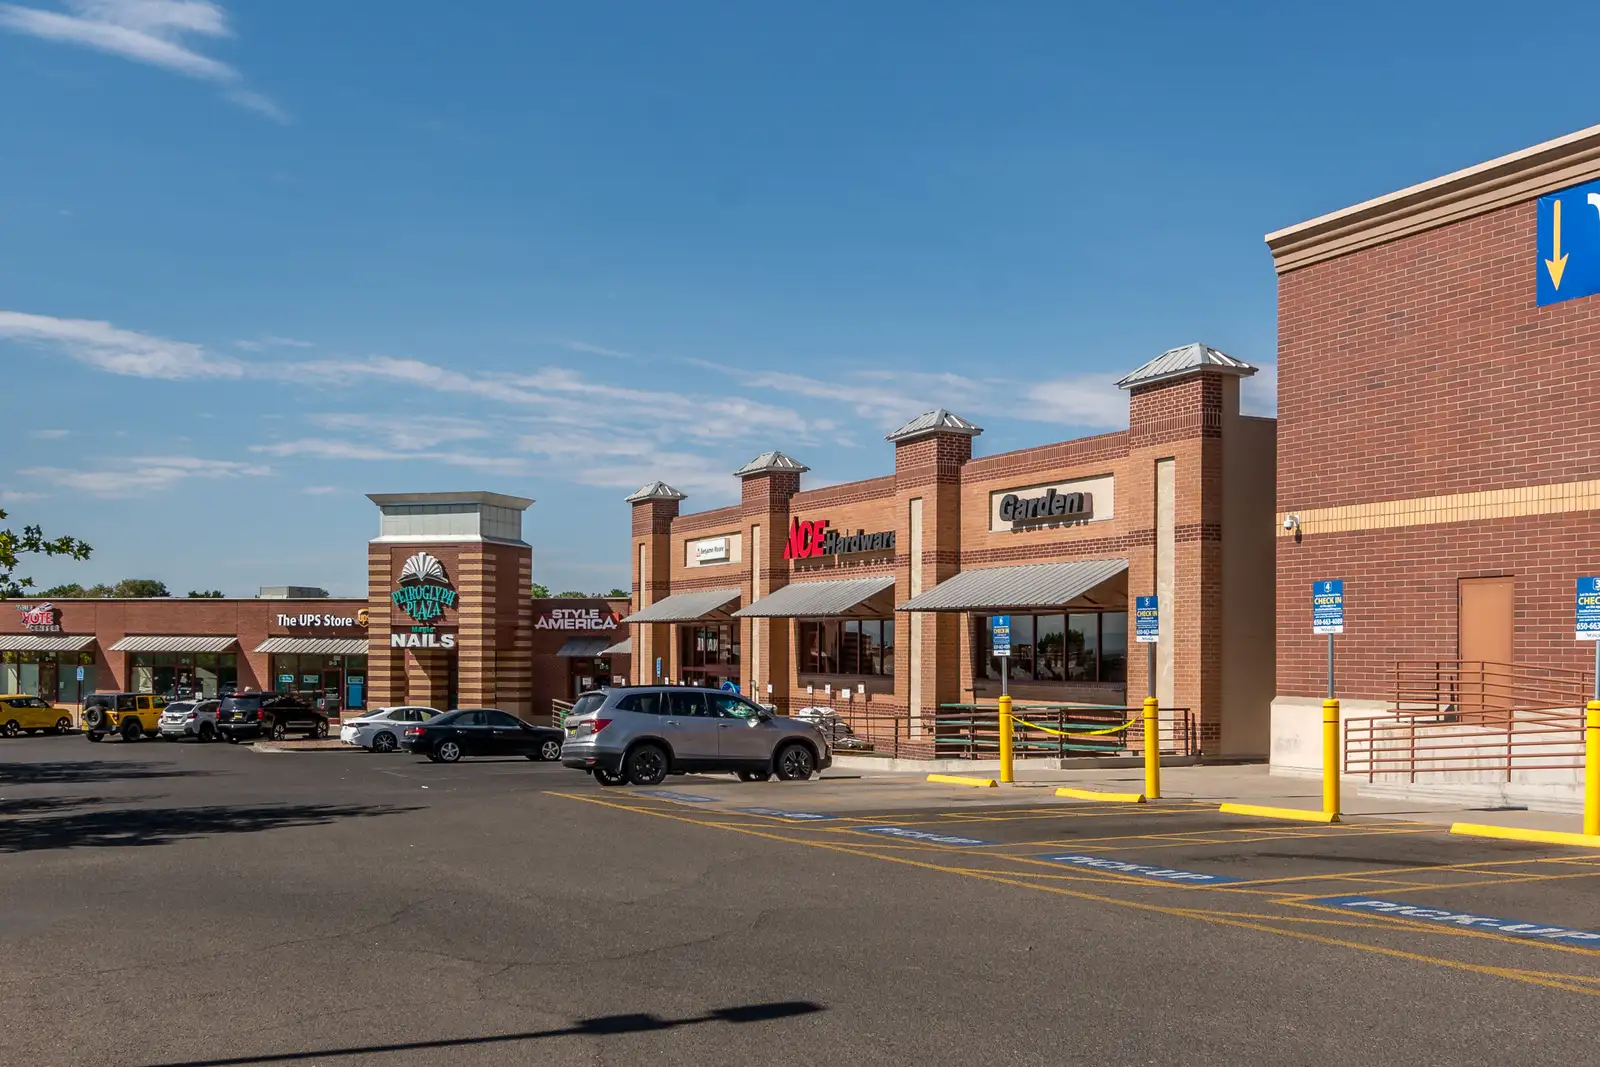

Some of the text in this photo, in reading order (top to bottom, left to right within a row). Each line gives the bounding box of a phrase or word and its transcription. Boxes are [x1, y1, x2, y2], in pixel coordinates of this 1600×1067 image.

[999, 488, 1080, 521] Garden
[783, 519, 827, 559] ACE
[391, 585, 456, 606] PETROGLYPH
[1314, 597, 1334, 605] CHECK
[277, 614, 352, 626] The UPS Store
[406, 600, 441, 620] PLAZA
[552, 609, 599, 618] STYLE
[534, 616, 618, 629] AMERICA
[391, 634, 455, 648] NAILS
[1053, 856, 1214, 880] PICK-UP
[1342, 900, 1600, 939] PICK-UP
